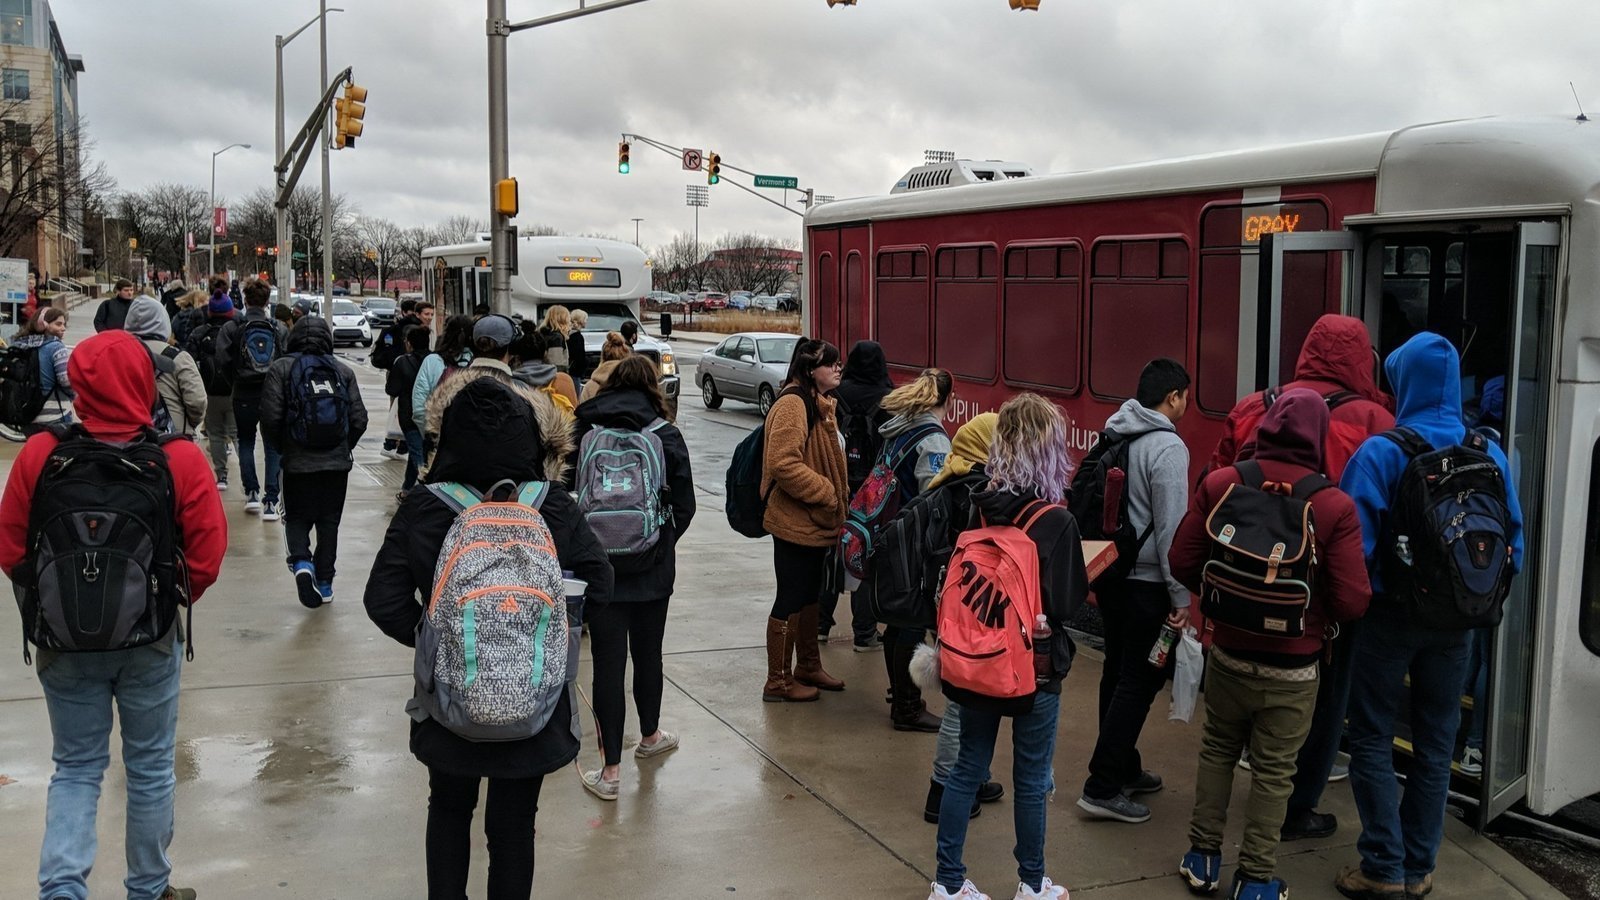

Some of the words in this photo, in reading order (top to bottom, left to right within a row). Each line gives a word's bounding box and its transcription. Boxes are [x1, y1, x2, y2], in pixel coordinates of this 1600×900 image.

[757, 177, 785, 186] Vermont
[787, 179, 796, 187] St
[1244, 213, 1299, 241] GRAY
[568, 271, 592, 281] GRAY
[956, 560, 1012, 630] PINK
